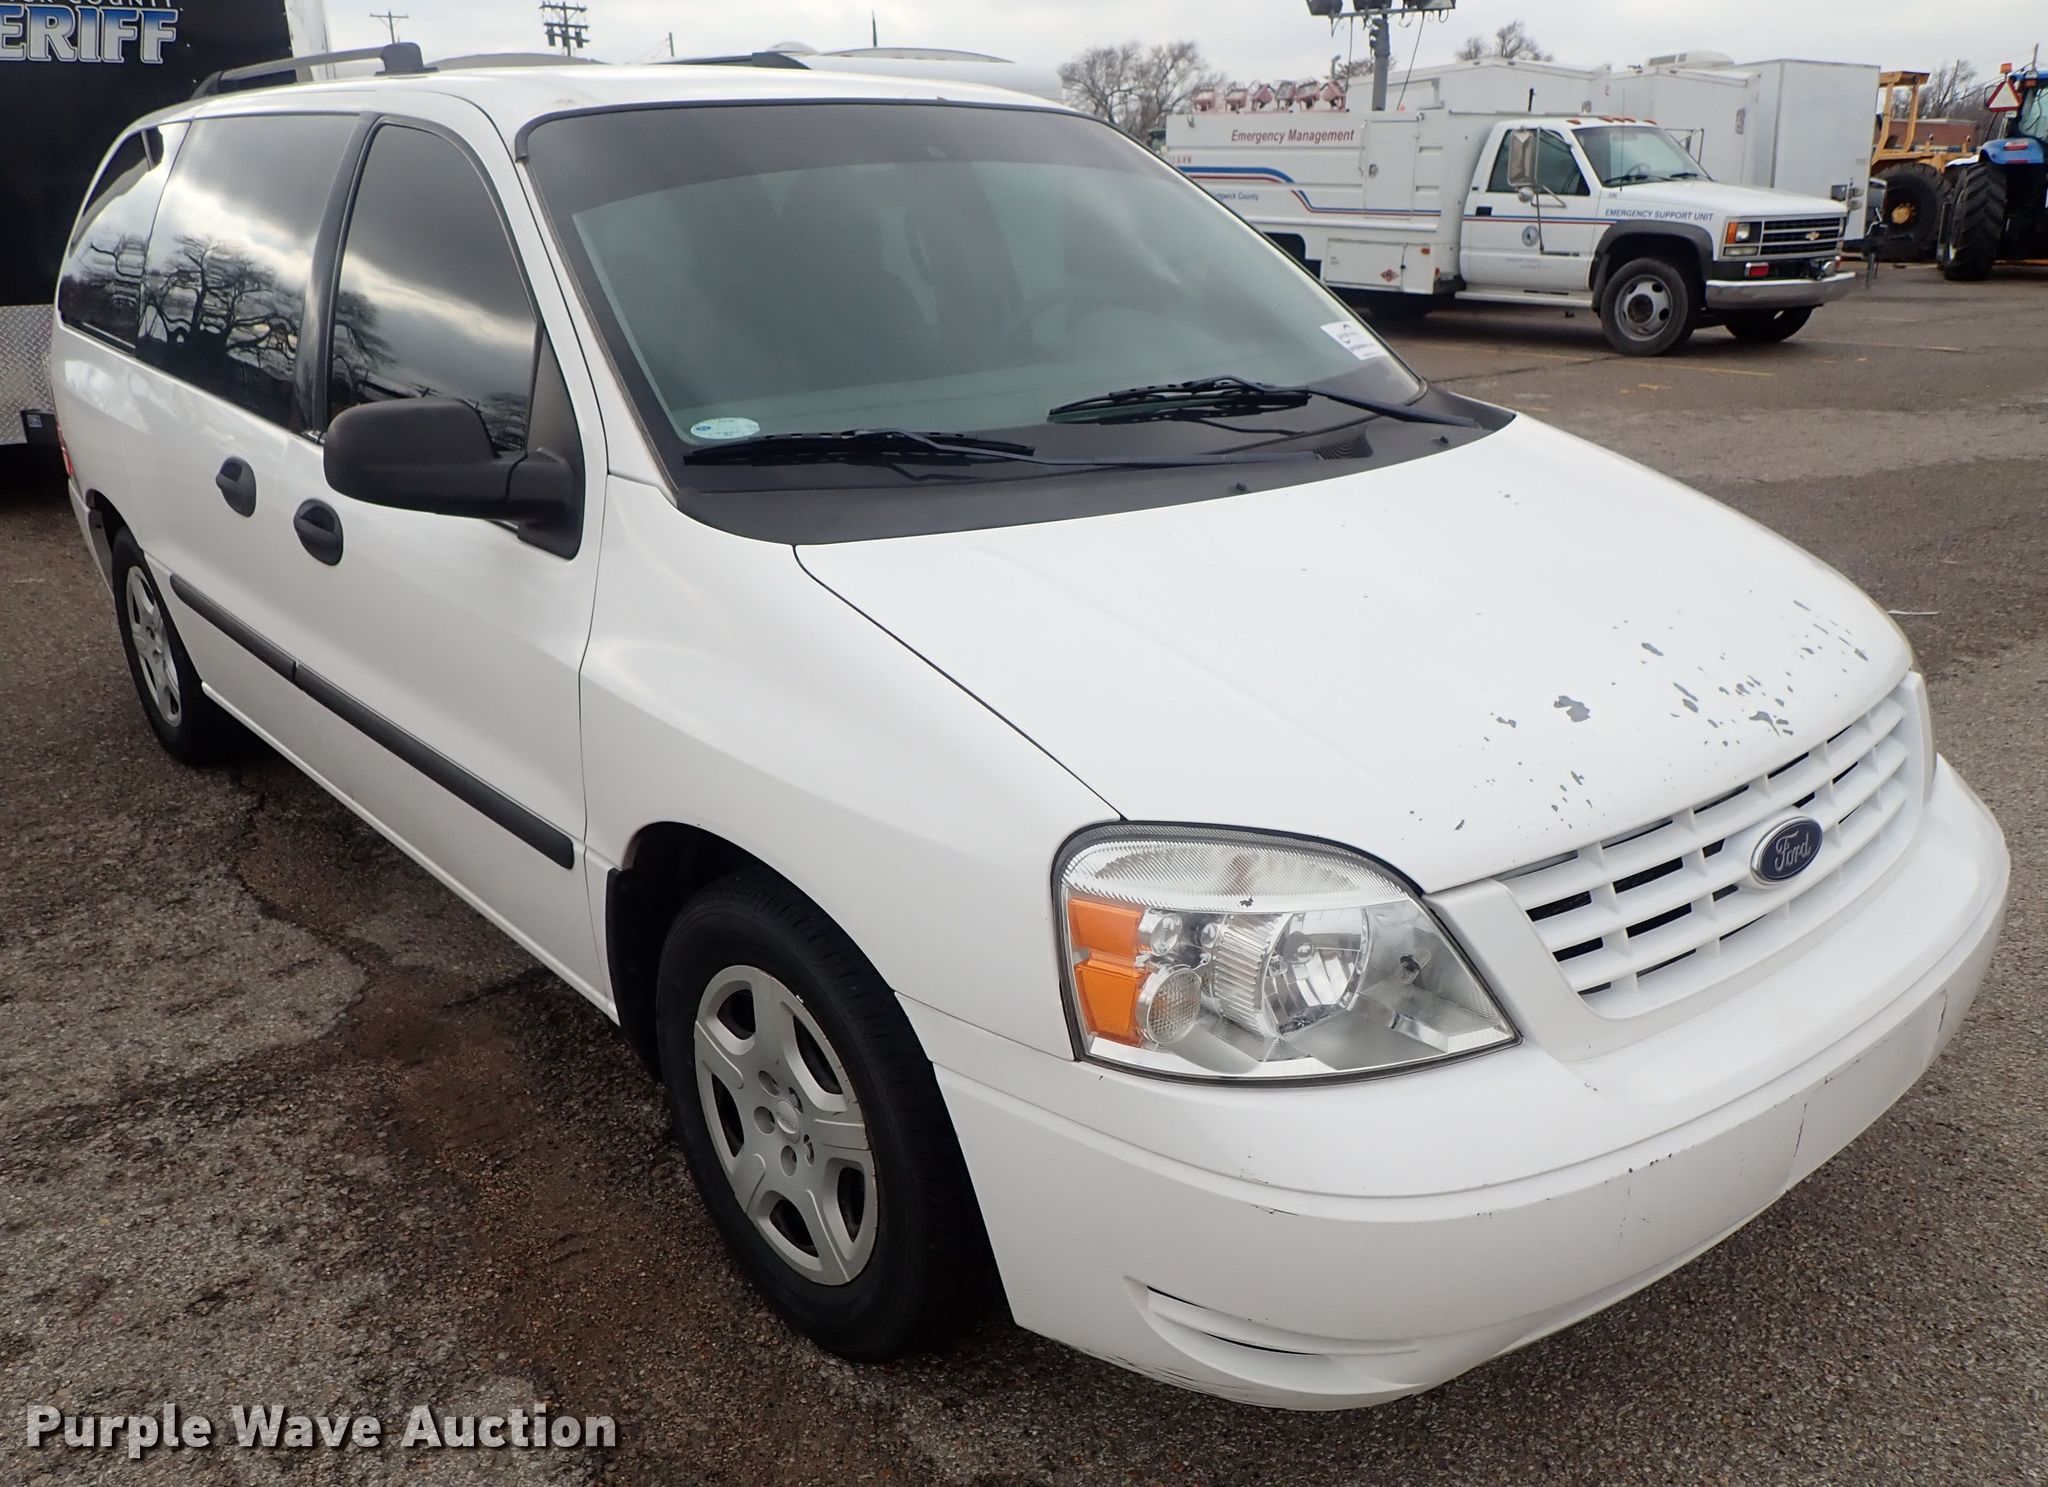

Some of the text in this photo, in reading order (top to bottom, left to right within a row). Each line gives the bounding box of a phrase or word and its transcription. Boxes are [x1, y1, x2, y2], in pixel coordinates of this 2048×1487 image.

[1231, 129, 1354, 144] Emergency Management
[1605, 208, 1714, 221] EMERGENCY SUPPORT UNIT
[1774, 830, 1812, 871] Ford
